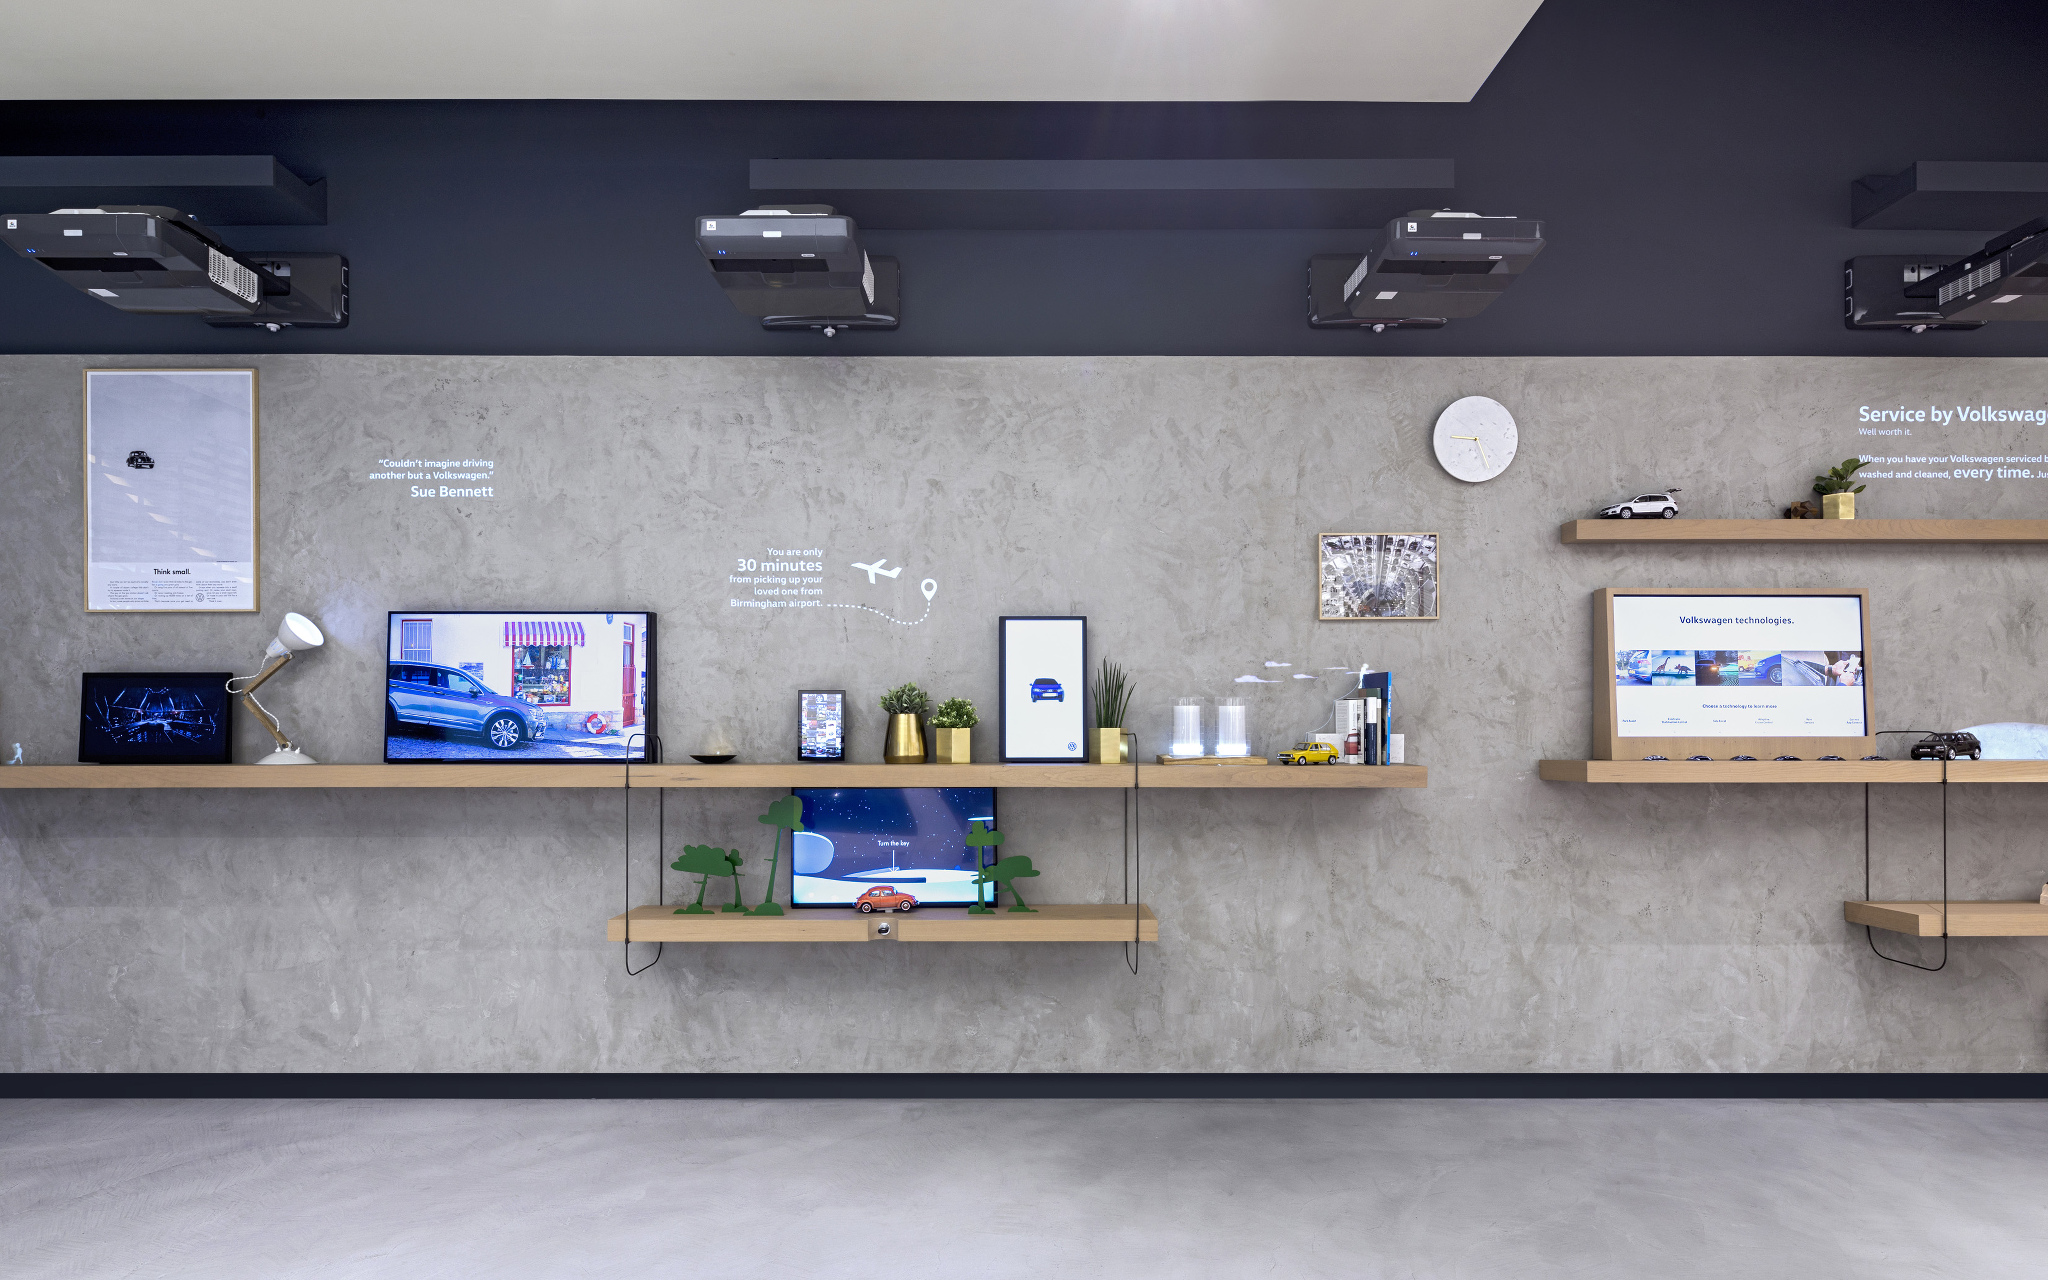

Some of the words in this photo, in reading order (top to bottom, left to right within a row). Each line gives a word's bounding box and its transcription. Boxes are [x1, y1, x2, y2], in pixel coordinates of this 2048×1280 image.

[1859, 405, 1926, 422] Service
[1931, 405, 1953, 426] by
[1956, 405, 2048, 426] Volkswag
[1858, 428, 1877, 436] Well
[1878, 428, 1902, 436] worth
[1904, 428, 1912, 436] it.
[424, 459, 461, 469] imagine
[462, 459, 494, 469] driving
[1858, 454, 1885, 463] When
[1887, 456, 1903, 465] you
[1905, 454, 1926, 463] have
[1928, 456, 1948, 465] your
[1950, 454, 2004, 465] Volkswagen
[2005, 454, 2042, 463] serviced
[369, 471, 406, 480] another
[407, 471, 424, 480] but
[425, 472, 431, 480] a
[432, 471, 494, 481] Volkswagen."
[1858, 470, 1893, 479] washed
[1895, 470, 1912, 479] and
[1914, 470, 1951, 480] cleaned,
[1953, 468, 1994, 481] every
[1996, 466, 2035, 479] time.
[410, 485, 436, 498] Sue
[439, 485, 494, 498] Bennett
[767, 547, 784, 556] You
[803, 547, 824, 557] only
[737, 558, 757, 572] 30
[760, 558, 823, 572] minutes
[729, 575, 752, 583] from
[753, 575, 787, 585] picking
[788, 577, 801, 585] up
[802, 576, 823, 585] your
[754, 587, 779, 595] loved
[800, 587, 823, 595] from
[730, 599, 787, 610] Birmingham
[788, 599, 823, 609] airport.
[1679, 616, 1733, 626] Volkswagen
[1735, 616, 1795, 626] technologies.
